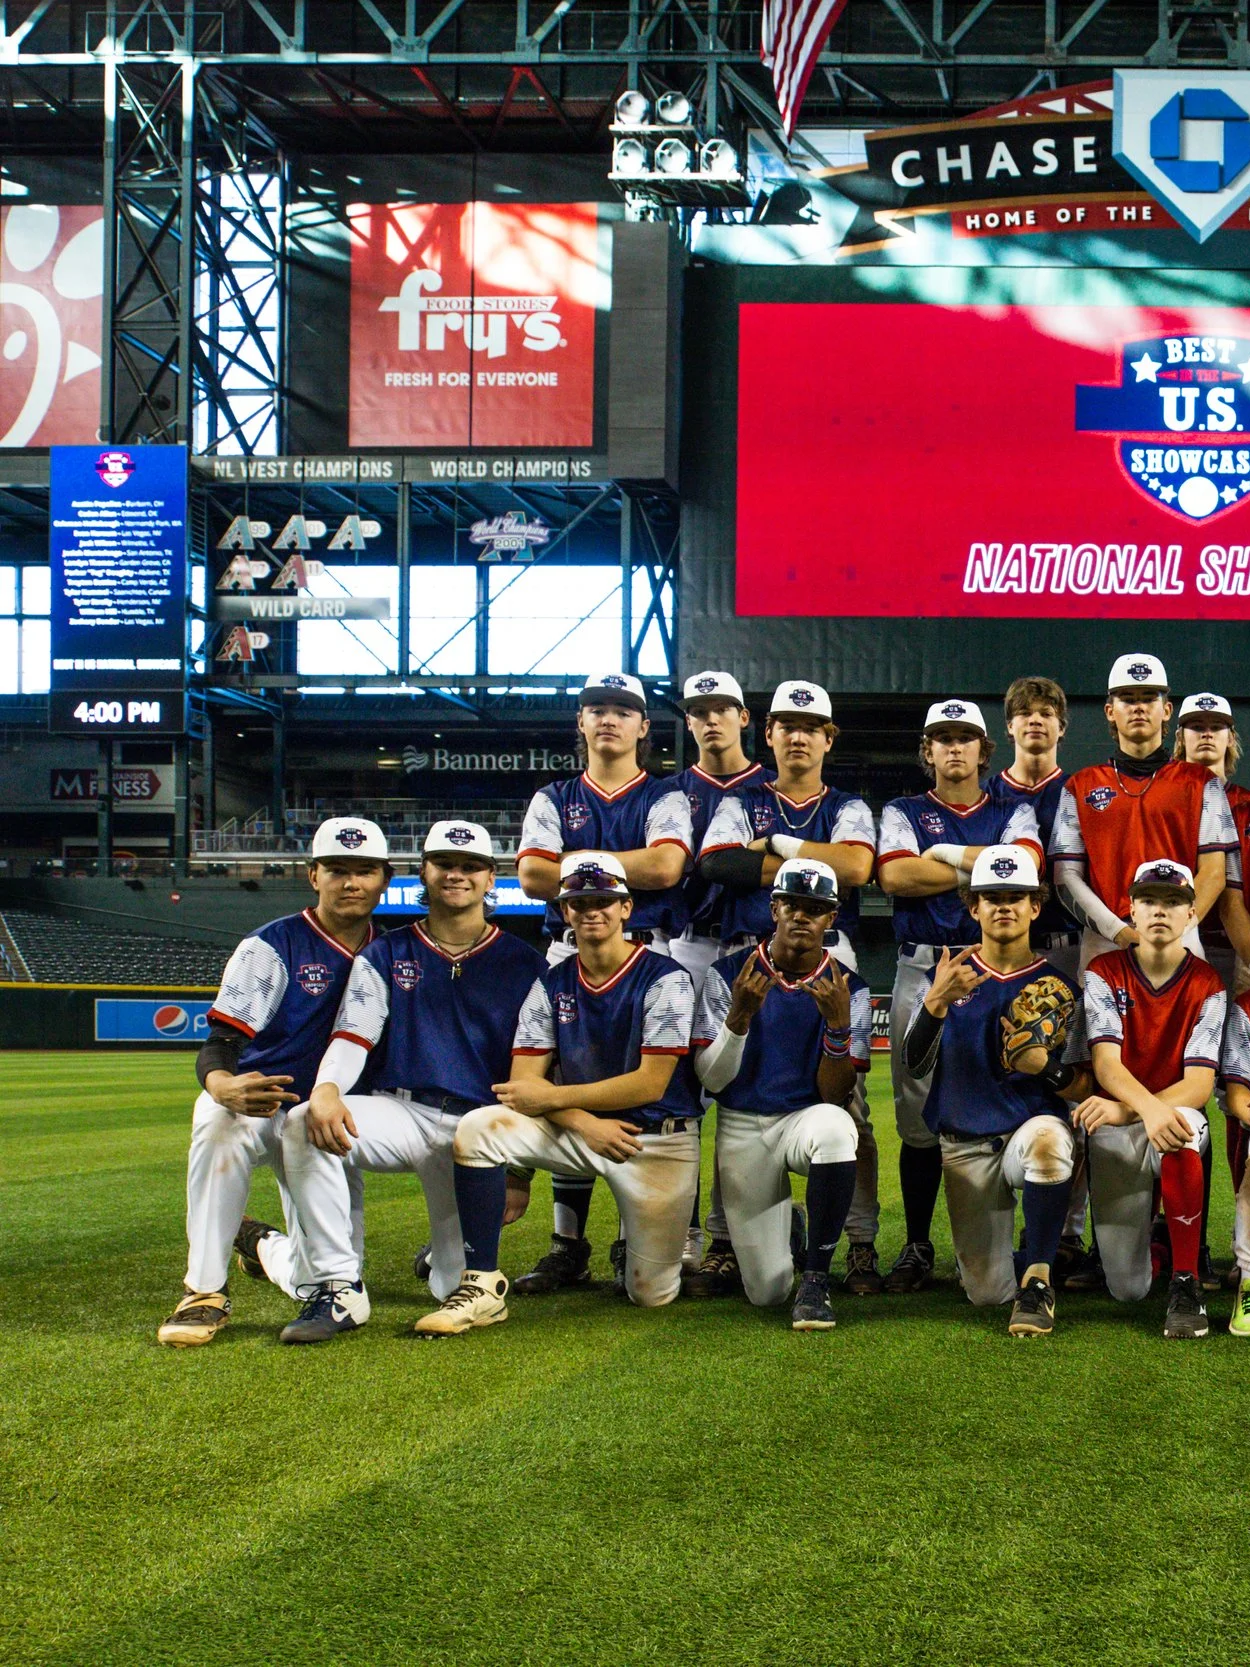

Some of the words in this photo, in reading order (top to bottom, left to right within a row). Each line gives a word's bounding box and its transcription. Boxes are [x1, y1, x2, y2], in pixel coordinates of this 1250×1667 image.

[891, 135, 1097, 188] CHASE
[966, 207, 1036, 229] HOME
[1056, 206, 1086, 223] OF
[1106, 205, 1152, 221] THE
[426, 298, 472, 311] FOOD
[482, 297, 550, 311] STORES
[1164, 337, 1236, 364] BEST
[385, 373, 434, 387] FRESH
[438, 373, 470, 387] FOR
[477, 372, 558, 387] EVERYONE
[1159, 387, 1244, 432] U.S.
[214, 461, 235, 478] NL
[240, 461, 287, 478] WEST
[293, 460, 393, 478] CHAMPIONS
[431, 460, 487, 478] WORLD
[492, 460, 592, 478] CHAMPIONS
[494, 538, 526, 549] 2001
[963, 542, 1184, 594] NATIONAL
[250, 600, 294, 617] WILD
[300, 600, 346, 617] CARD
[74, 702, 123, 723] 4:00
[128, 702, 160, 723] PM
[433, 748, 523, 771] Banner
[528, 748, 585, 771] Heal
[89, 781, 150, 796] FNESS
